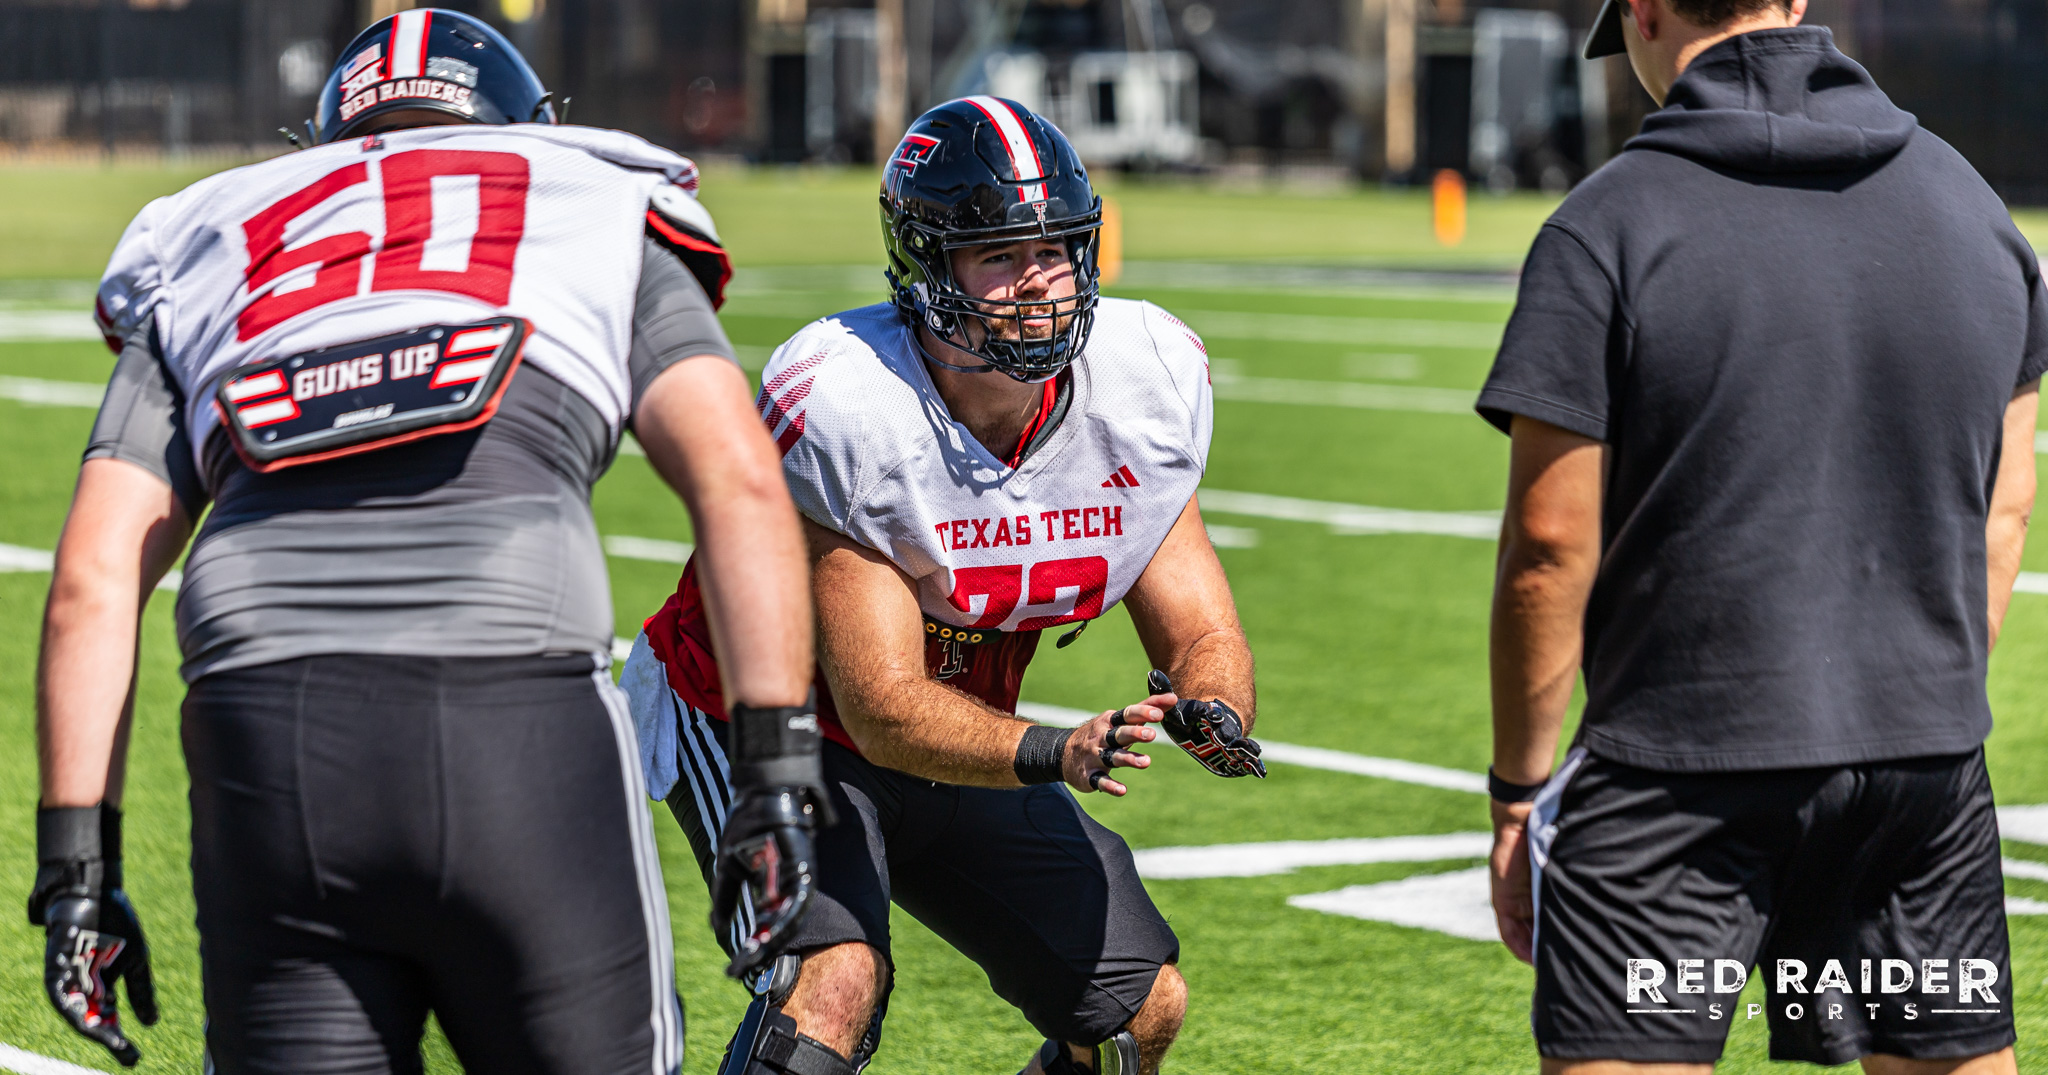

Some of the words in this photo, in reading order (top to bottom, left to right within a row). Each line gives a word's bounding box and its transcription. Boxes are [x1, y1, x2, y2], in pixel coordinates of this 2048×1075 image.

[339, 87, 377, 121] RED
[379, 79, 471, 106] RAIDERS
[293, 353, 382, 402] GUNS
[390, 342, 439, 381] UP
[935, 515, 1032, 553] TEXAS
[1040, 505, 1123, 542] TECH
